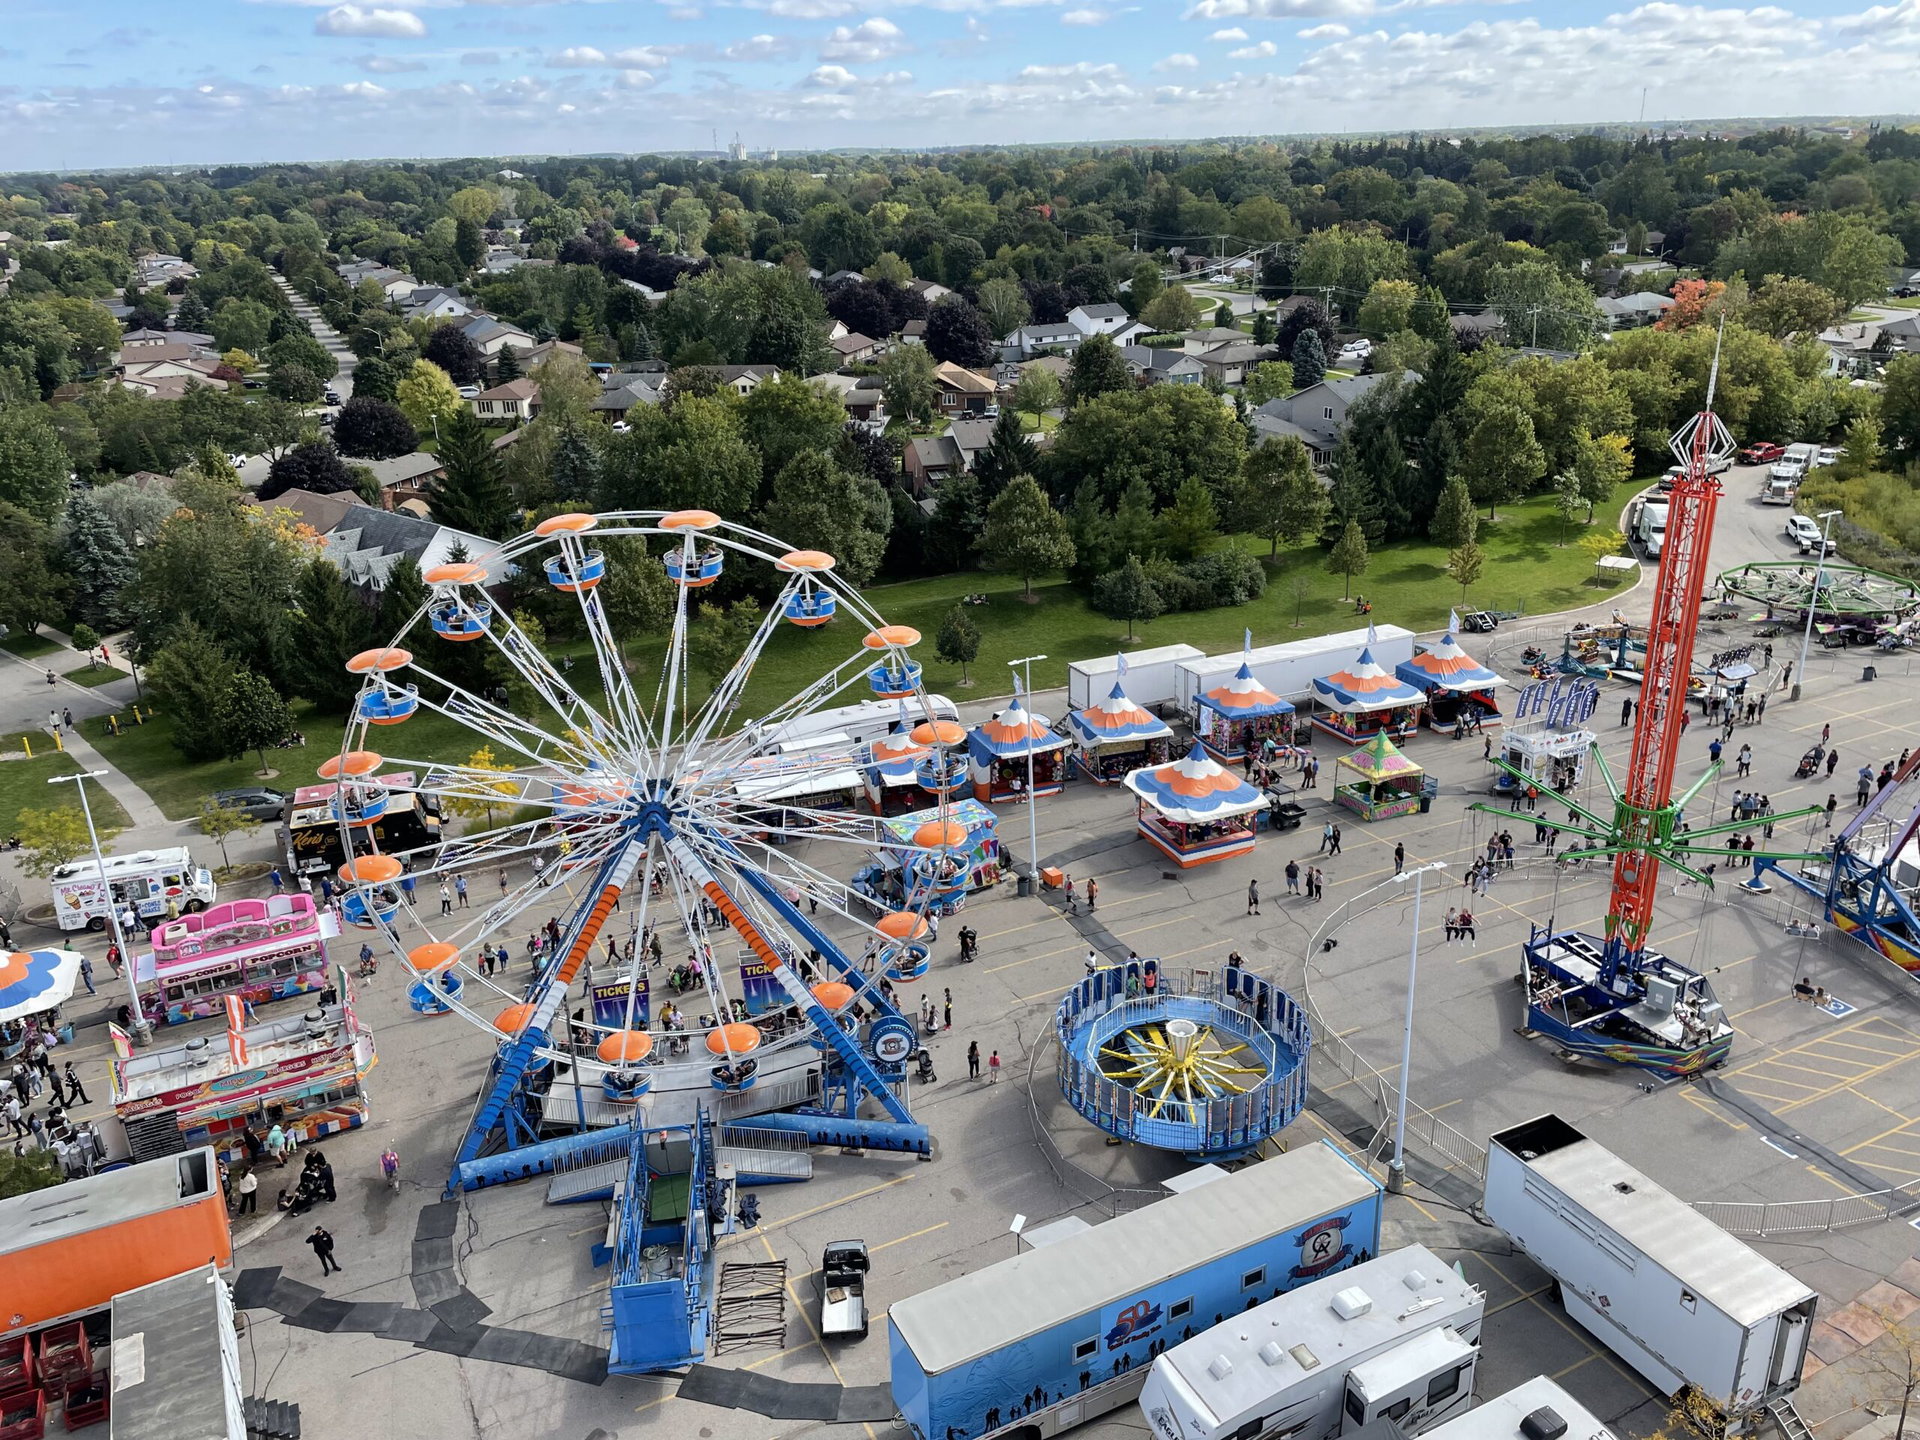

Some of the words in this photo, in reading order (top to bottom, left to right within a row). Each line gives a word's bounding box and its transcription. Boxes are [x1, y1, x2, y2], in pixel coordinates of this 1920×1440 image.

[250, 944, 312, 964] POPCORN
[167, 964, 232, 984] SNO-CONES
[594, 983, 646, 999] TICKES
[1116, 1300, 1151, 1340] 50
